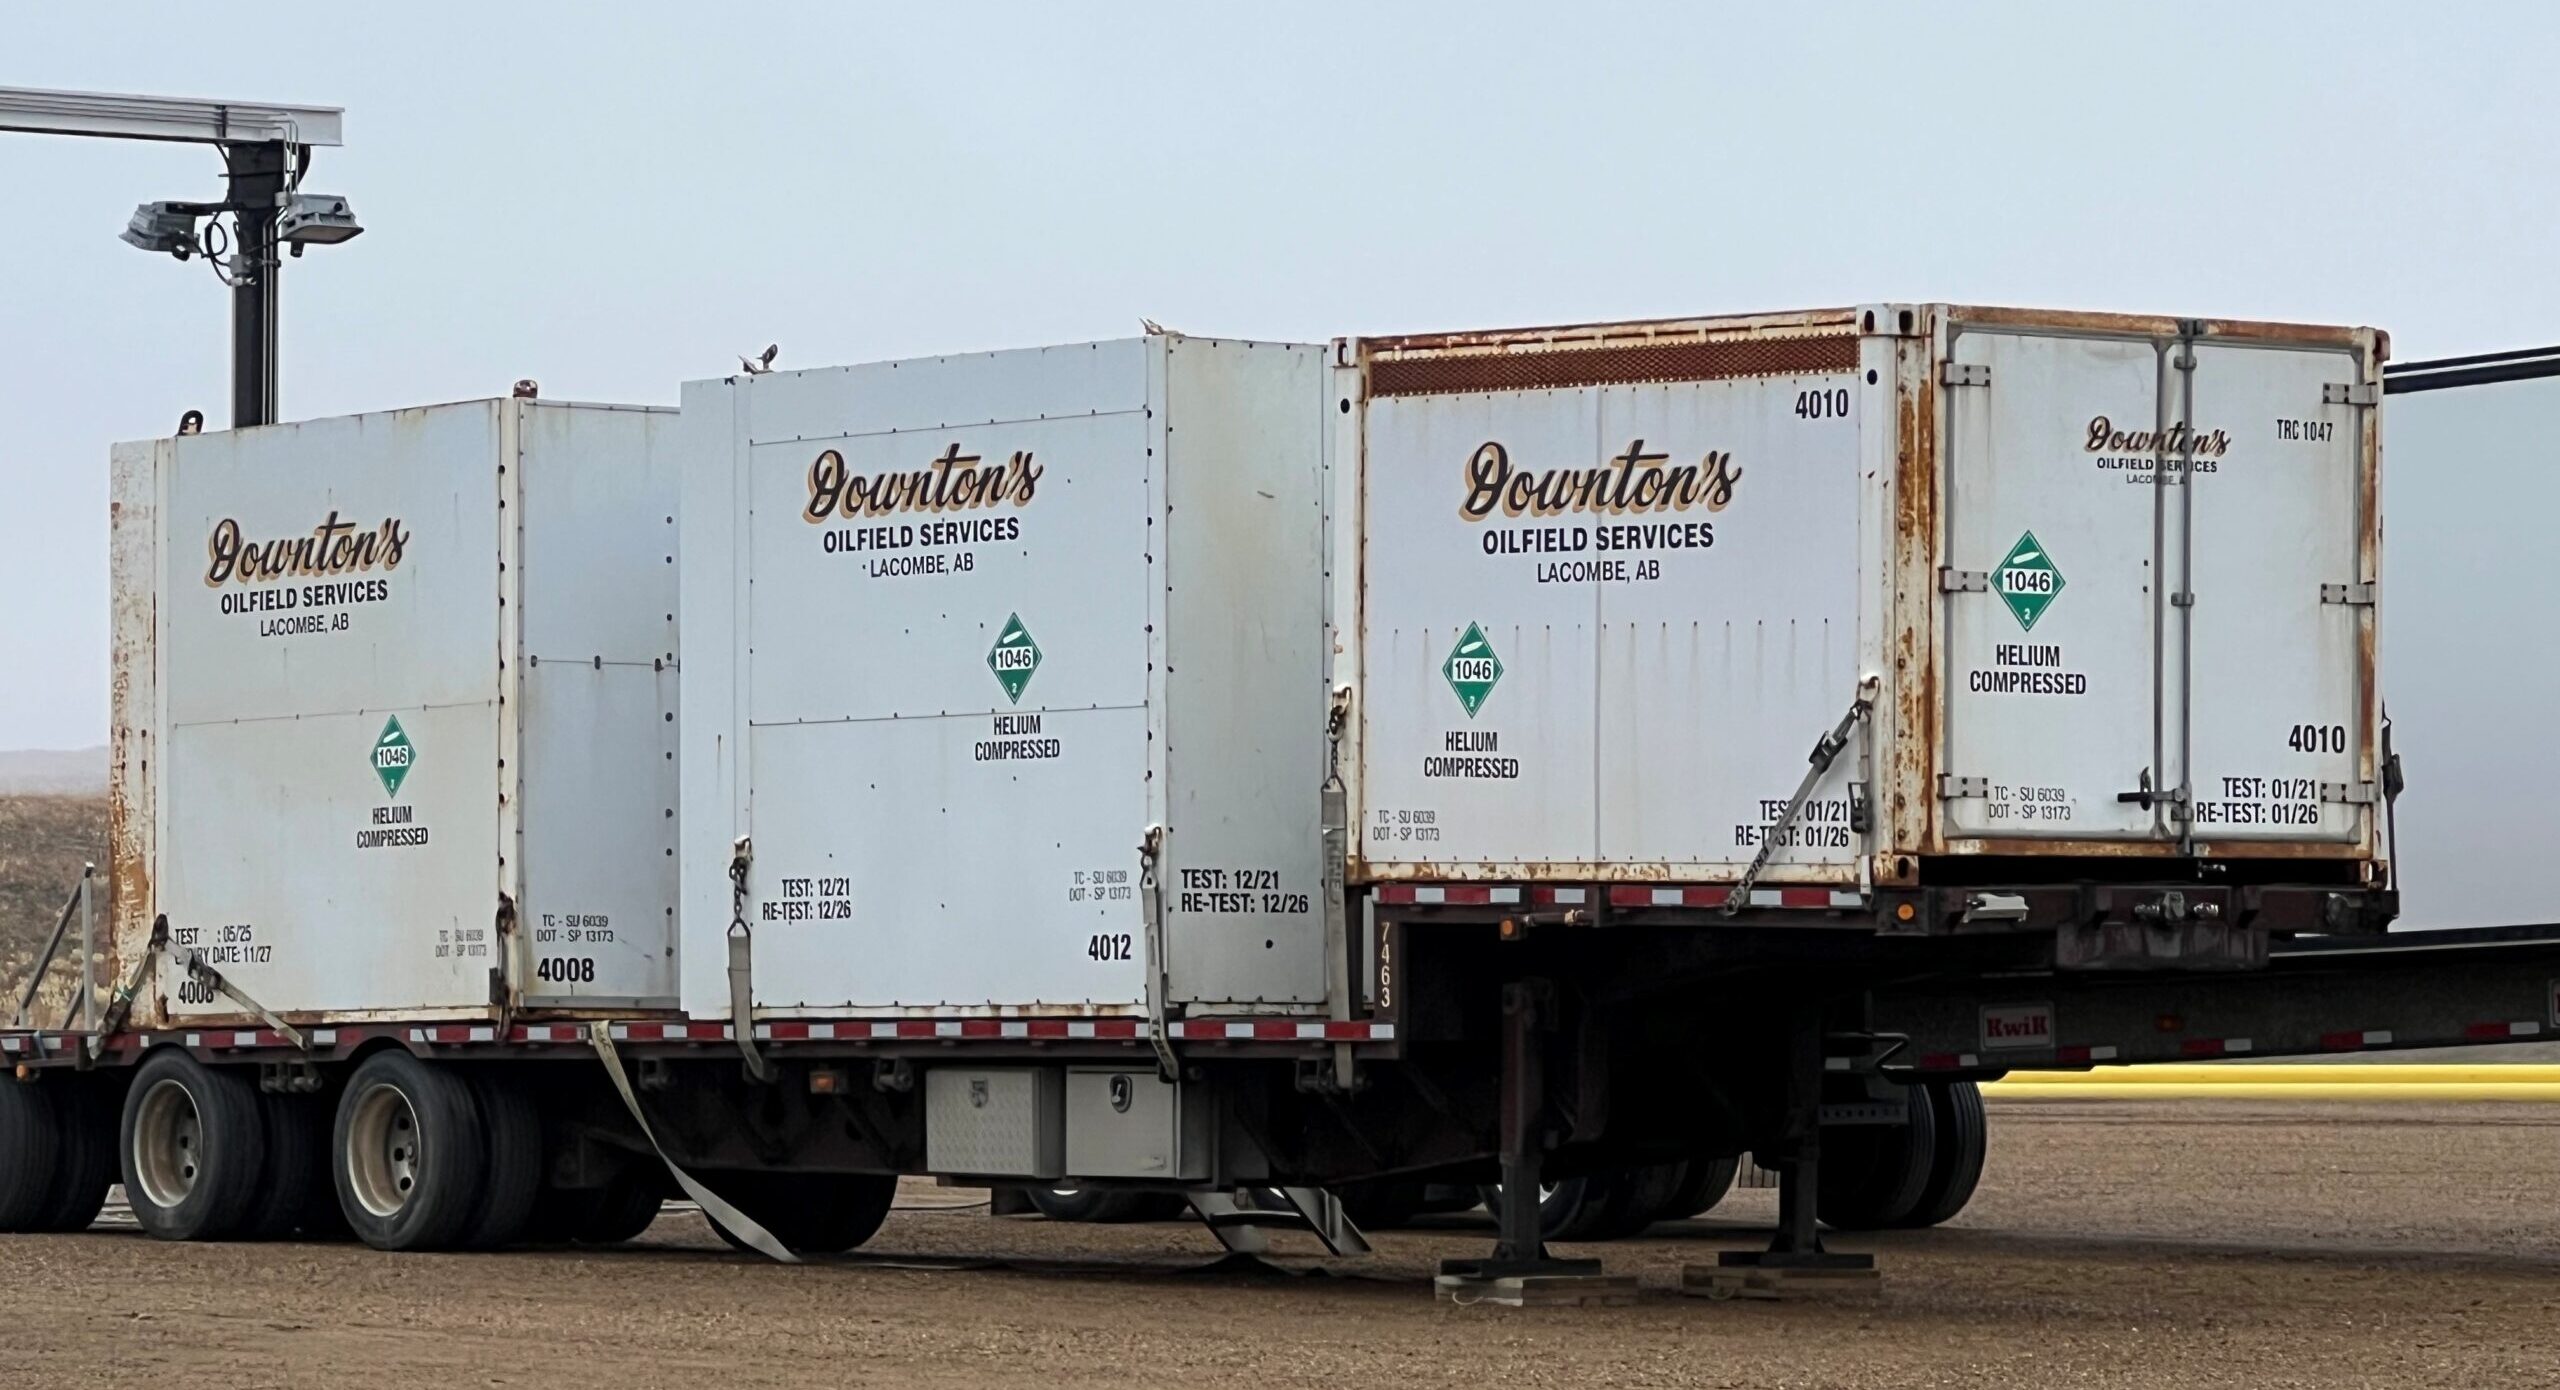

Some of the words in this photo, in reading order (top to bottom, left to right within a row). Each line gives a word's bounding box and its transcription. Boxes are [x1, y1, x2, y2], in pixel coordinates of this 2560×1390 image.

[1795, 389, 1849, 419] 4010
[2276, 419, 2299, 440] TRC
[2303, 421, 2333, 442] 1047
[2096, 457, 2154, 471] OILFIELD
[802, 443, 1043, 524] Downton's
[1458, 439, 1742, 522] Downton's
[823, 525, 913, 553] OILFIELD
[919, 516, 1019, 547] SERVICES
[1482, 527, 1588, 554] OILFIELD
[1595, 522, 1714, 551] SERVICES
[204, 511, 410, 588] Downton's
[870, 554, 949, 578] LACOMBE,
[953, 553, 974, 572] AB
[1537, 560, 1631, 584] LACOMBE,
[1635, 560, 1660, 580] AB
[2005, 571, 2051, 592] 1046
[220, 588, 298, 614] OILFIELD
[303, 579, 388, 607] SERVICES
[260, 615, 328, 637] LACOMBE,
[331, 613, 350, 631] AB
[2024, 608, 2030, 621] 2
[998, 648, 1032, 669] 1046
[1996, 645, 2061, 667] HELIUM
[1455, 660, 1492, 680] 1046
[1969, 670, 2086, 695] COMPRESSED
[993, 715, 1041, 736] HELIUM
[1445, 731, 1498, 752] HELIUM
[2289, 725, 2346, 753] 4010
[379, 747, 407, 766] 1046
[975, 739, 1060, 762] COMPRESSED
[1424, 757, 1519, 779] COMPRESSED
[1994, 786, 2008, 800] TC
[2020, 787, 2034, 801] SU
[2037, 787, 2065, 802] 6039
[2222, 777, 2266, 799] TEST:
[2272, 778, 2316, 800] 01/21
[372, 806, 412, 825] HELIUM
[1760, 800, 1801, 821] TES:
[1805, 800, 1848, 822] 01/21
[1989, 804, 2010, 819] DOT
[2022, 804, 2036, 819] SP
[2041, 804, 2071, 821] 13173
[2196, 802, 2266, 824] RE-TEST:
[2271, 803, 2318, 825] 01/26
[356, 827, 429, 848] COMPRESSED
[1373, 827, 1390, 841] DOT
[1400, 827, 1412, 841] SP
[1805, 826, 1849, 847] 01/26
[782, 879, 813, 898] TEST:
[818, 877, 850, 896] 12/21
[1181, 869, 1227, 890] TEST:
[1234, 870, 1279, 890] 12/21
[762, 901, 813, 921] RE-TEST:
[818, 900, 851, 919] 12/26
[1181, 893, 1256, 913] RE-TEST:
[1262, 894, 1309, 913] 12/26
[542, 914, 555, 927] TC
[583, 915, 609, 928] 6039
[175, 928, 200, 945] TEST
[536, 929, 557, 942] DOT
[568, 930, 582, 942] SP
[586, 930, 614, 943] 13173
[213, 946, 241, 964] DATE:
[243, 946, 272, 963] 11/27
[1088, 934, 1131, 960] 4012
[537, 958, 595, 982] 4008
[1381, 921, 1391, 1008] 7463
